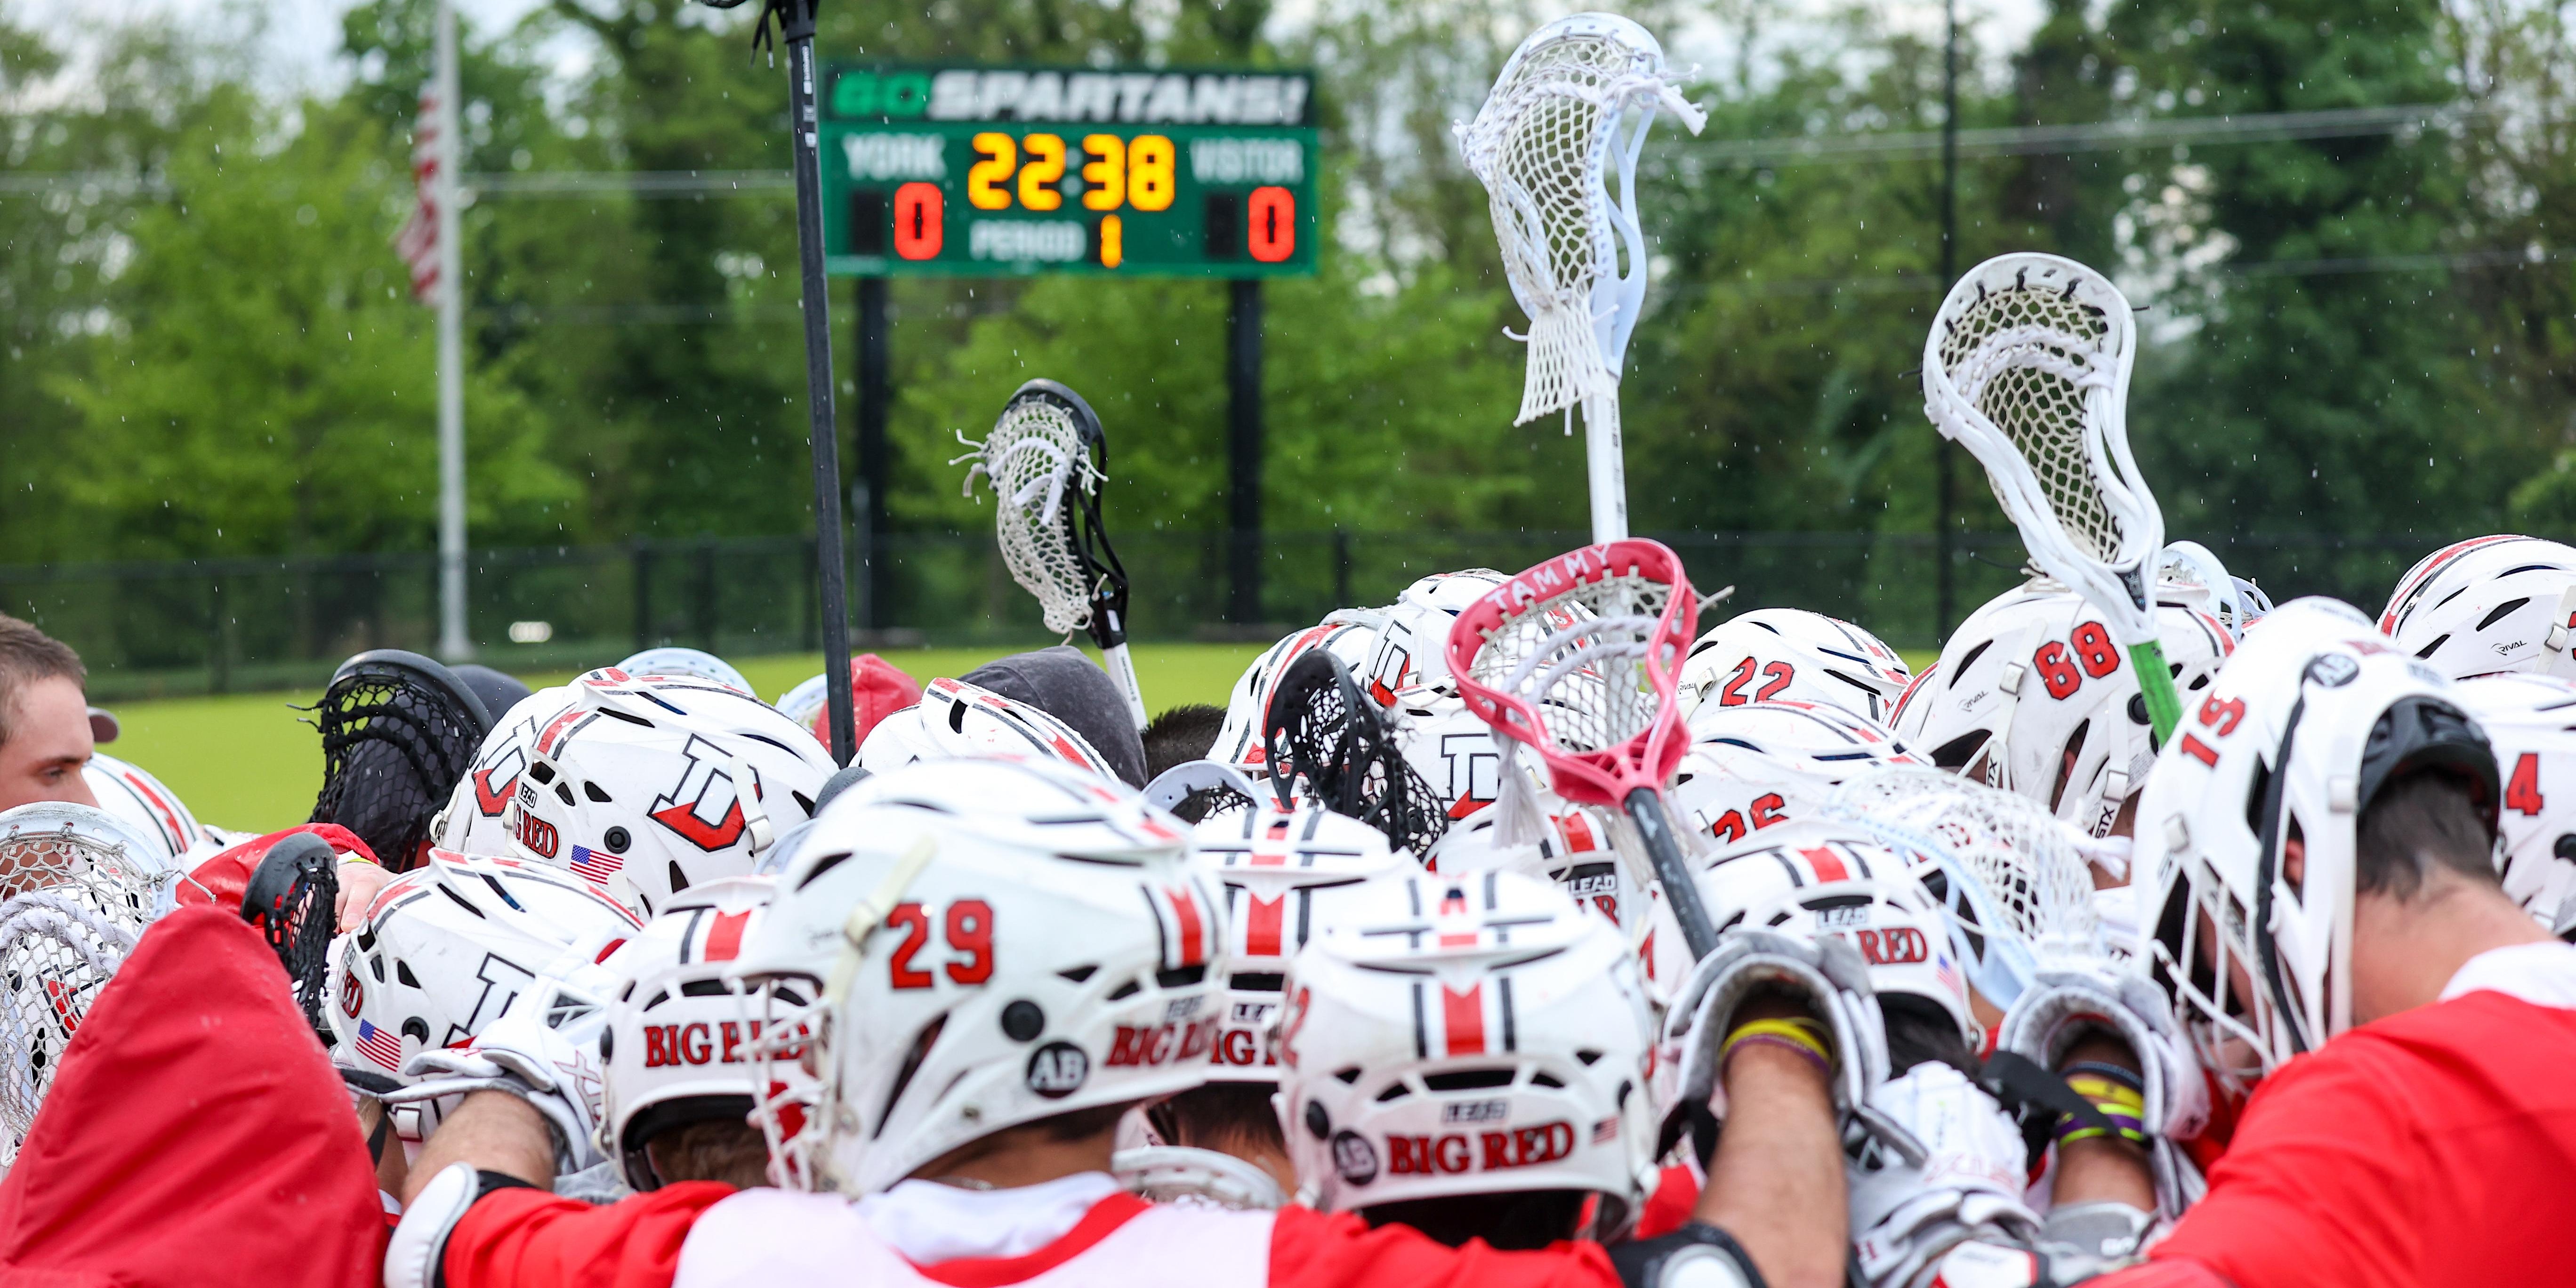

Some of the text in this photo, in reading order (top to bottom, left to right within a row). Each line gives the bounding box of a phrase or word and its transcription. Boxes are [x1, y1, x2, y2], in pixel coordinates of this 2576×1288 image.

[832, 70, 1309, 125] GO SPARTANS!
[844, 133, 946, 180] YORK
[968, 132, 1176, 211] 22:38
[894, 182, 943, 260] 0
[969, 220, 1087, 262] PERIOD
[1100, 214, 1122, 268] 1
[1248, 186, 1295, 262] 0
[1484, 544, 1611, 609] TAMMY
[2034, 621, 2120, 700] 88
[2490, 640, 2527, 656] RIVAL
[1720, 656, 1795, 707] 22
[519, 782, 537, 808] LEAD
[2506, 752, 2543, 815] 4
[523, 809, 559, 859] RED
[2096, 805, 2115, 838] STX
[1569, 875, 1617, 894] LEAD
[887, 900, 993, 990] 29
[1856, 928, 1927, 965] RED
[644, 1023, 712, 1067] BIG
[1028, 1049, 1087, 1090] AB
[1388, 1121, 1574, 1174] BIG RED
